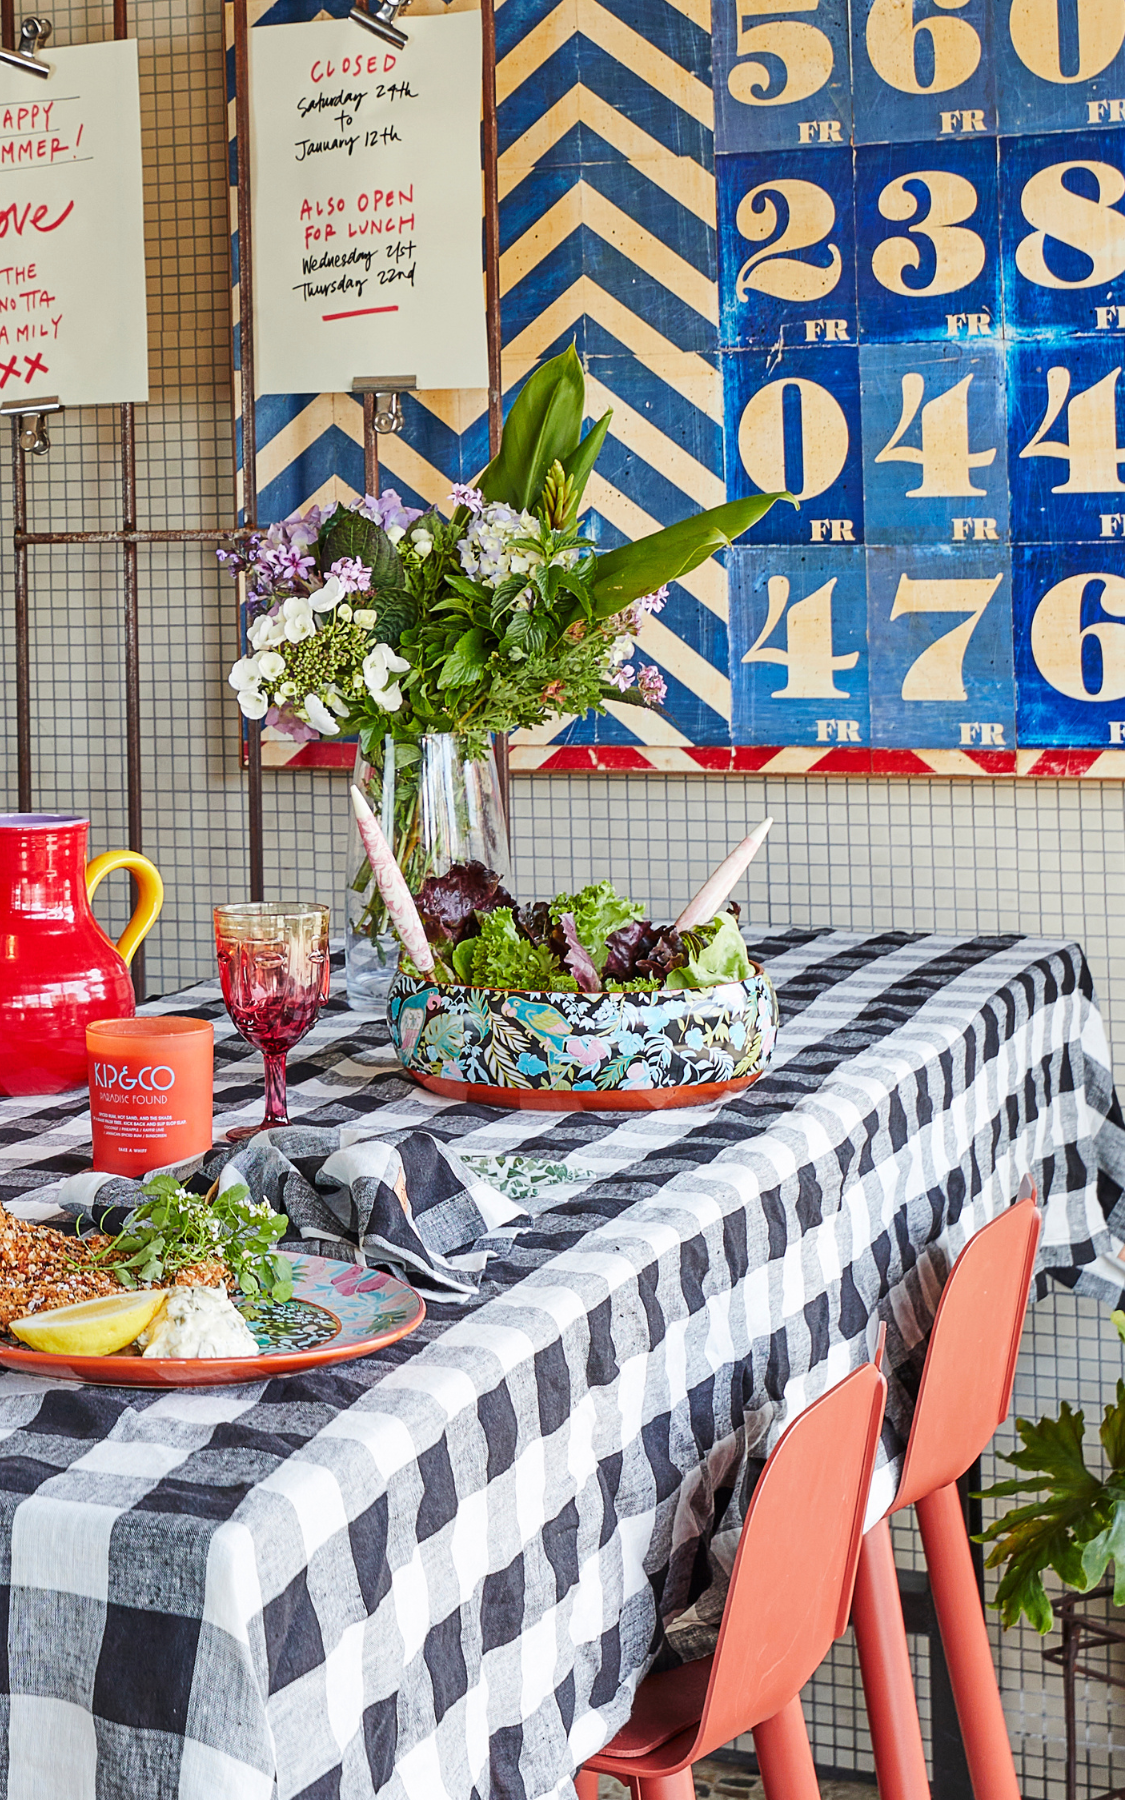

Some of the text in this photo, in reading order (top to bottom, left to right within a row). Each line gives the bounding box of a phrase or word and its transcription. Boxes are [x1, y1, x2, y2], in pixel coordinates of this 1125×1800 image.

[310, 53, 397, 83] CLOSED
[727, 0, 835, 107] 5
[865, 0, 982, 95] 6
[296, 81, 420, 118] Saturday 24th
[334, 110, 353, 132] to
[797, 120, 843, 145] FR
[939, 109, 988, 134] FR
[294, 124, 403, 162] January 12th
[299, 183, 415, 221] ALSO OPEN
[304, 213, 415, 250] FOR LUNCH
[735, 160, 1125, 304] 2 3 8
[301, 240, 418, 277] Wednesday 21st
[291, 261, 418, 302] Thursday 22nd
[803, 318, 850, 343] FR
[944, 312, 993, 337] FR
[737, 365, 1125, 502] 0 4 4
[809, 512, 1125, 543] FR FR F
[740, 571, 1125, 703] 4 7 6
[814, 718, 863, 743] FR
[958, 721, 1008, 746] FR
[94, 1062, 176, 1091] KIP&CO
[99, 1091, 169, 1106] PARADISE FOUND
